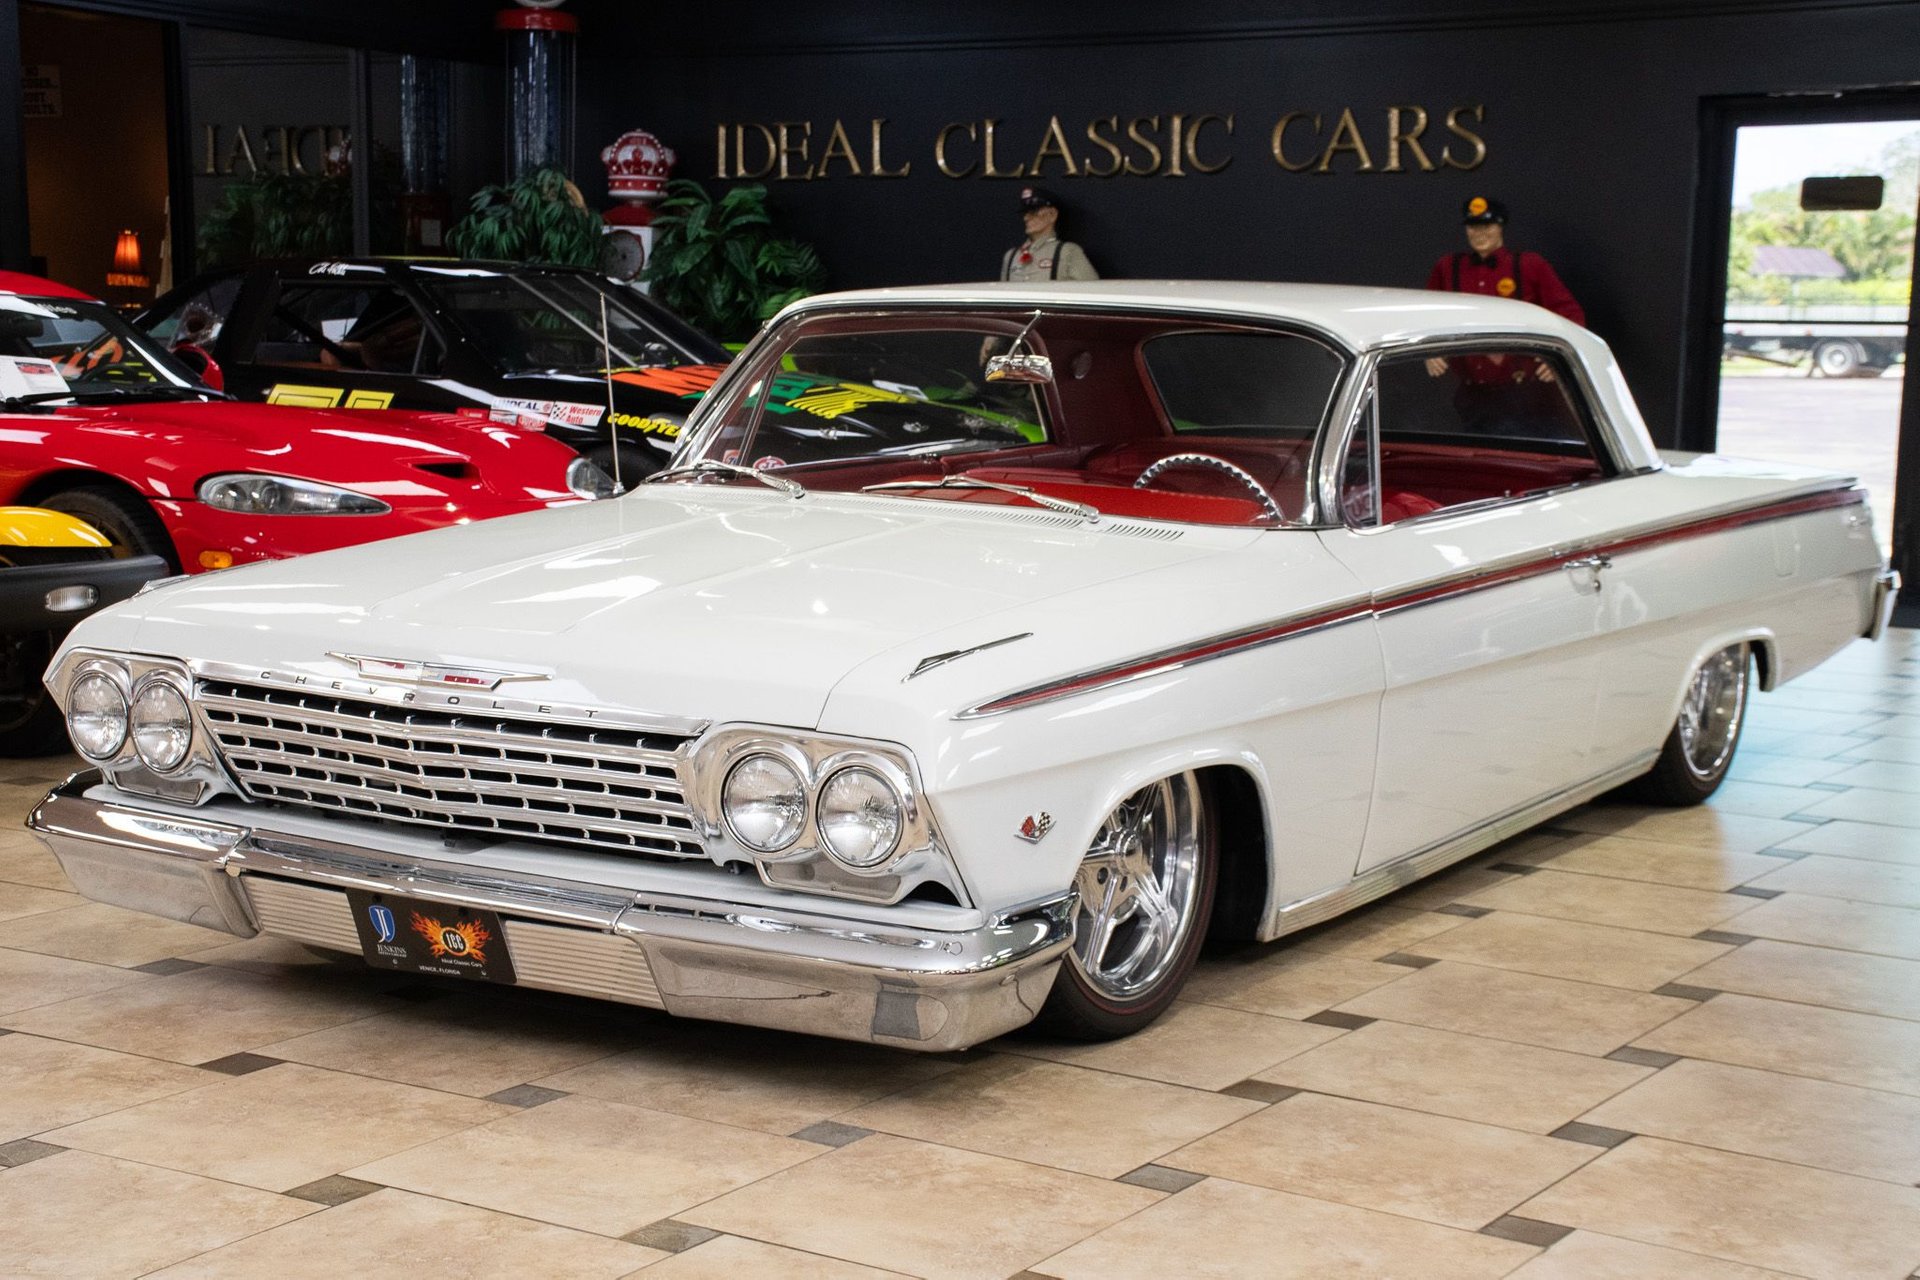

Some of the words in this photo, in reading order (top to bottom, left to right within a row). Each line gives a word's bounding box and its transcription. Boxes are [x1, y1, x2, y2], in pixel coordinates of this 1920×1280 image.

[713, 118, 911, 180] IDEAL
[934, 113, 1235, 178] CLASSIC
[1271, 104, 1487, 173] CARS
[566, 414, 584, 424] Auto
[569, 406, 603, 416] Western
[607, 412, 679, 437] GOODYEA
[260, 671, 599, 719] CHEVROLET
[446, 932, 464, 951] ICC
[439, 967, 461, 975] FLORIDA
